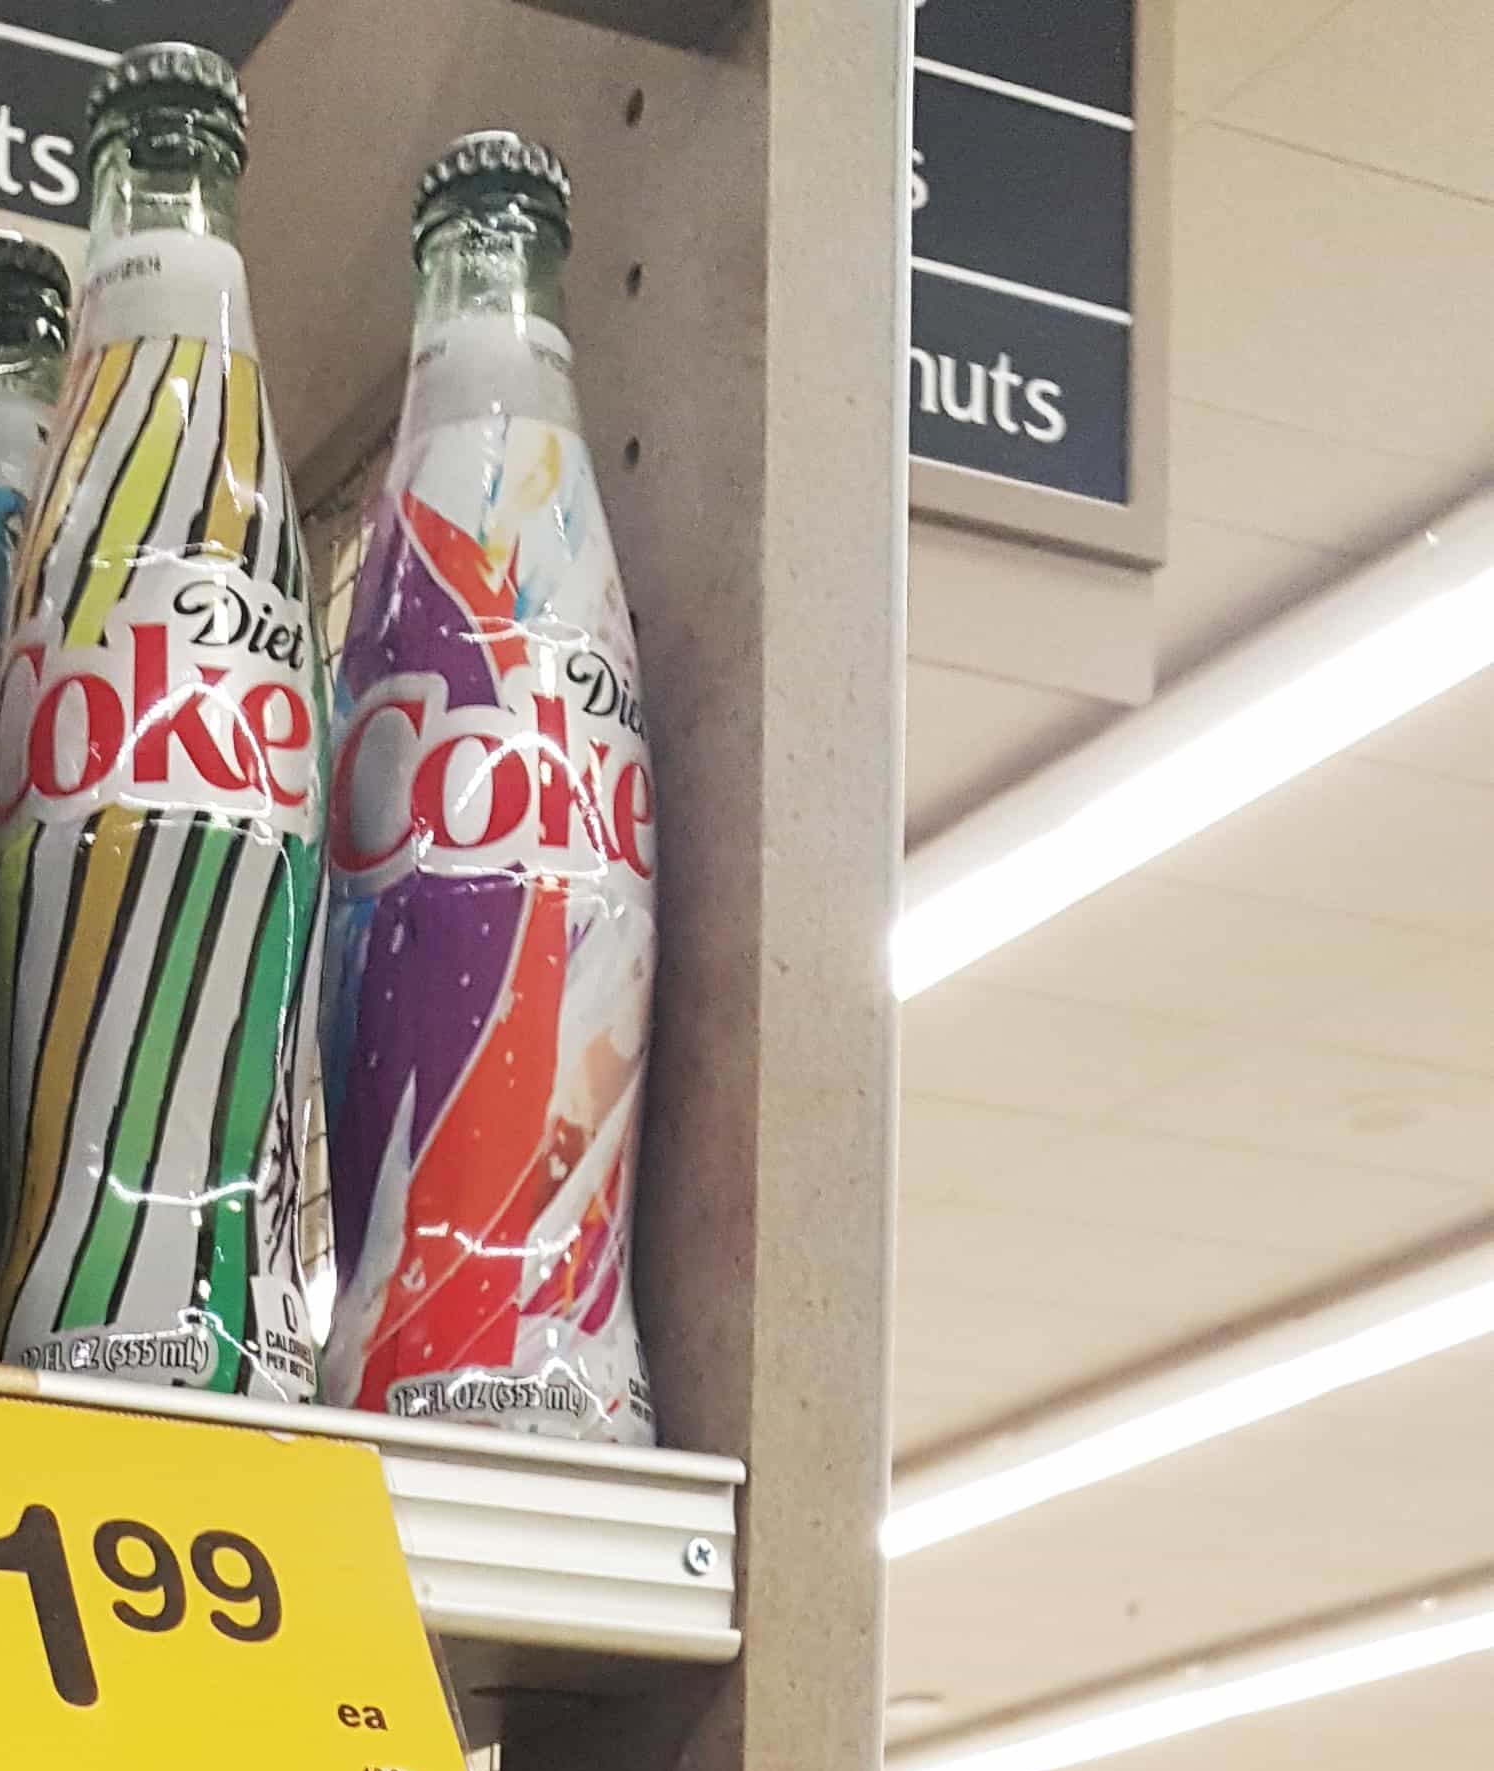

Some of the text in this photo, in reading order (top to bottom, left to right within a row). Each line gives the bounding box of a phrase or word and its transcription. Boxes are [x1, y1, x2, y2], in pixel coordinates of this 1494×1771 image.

[174, 582, 305, 670] Diet
[332, 696, 655, 880] Coke
[283, 1294, 298, 1333] 0
[160, 1334, 210, 1373] mL)
[455, 1383, 486, 1410] OZ
[337, 1703, 388, 1731] ea
